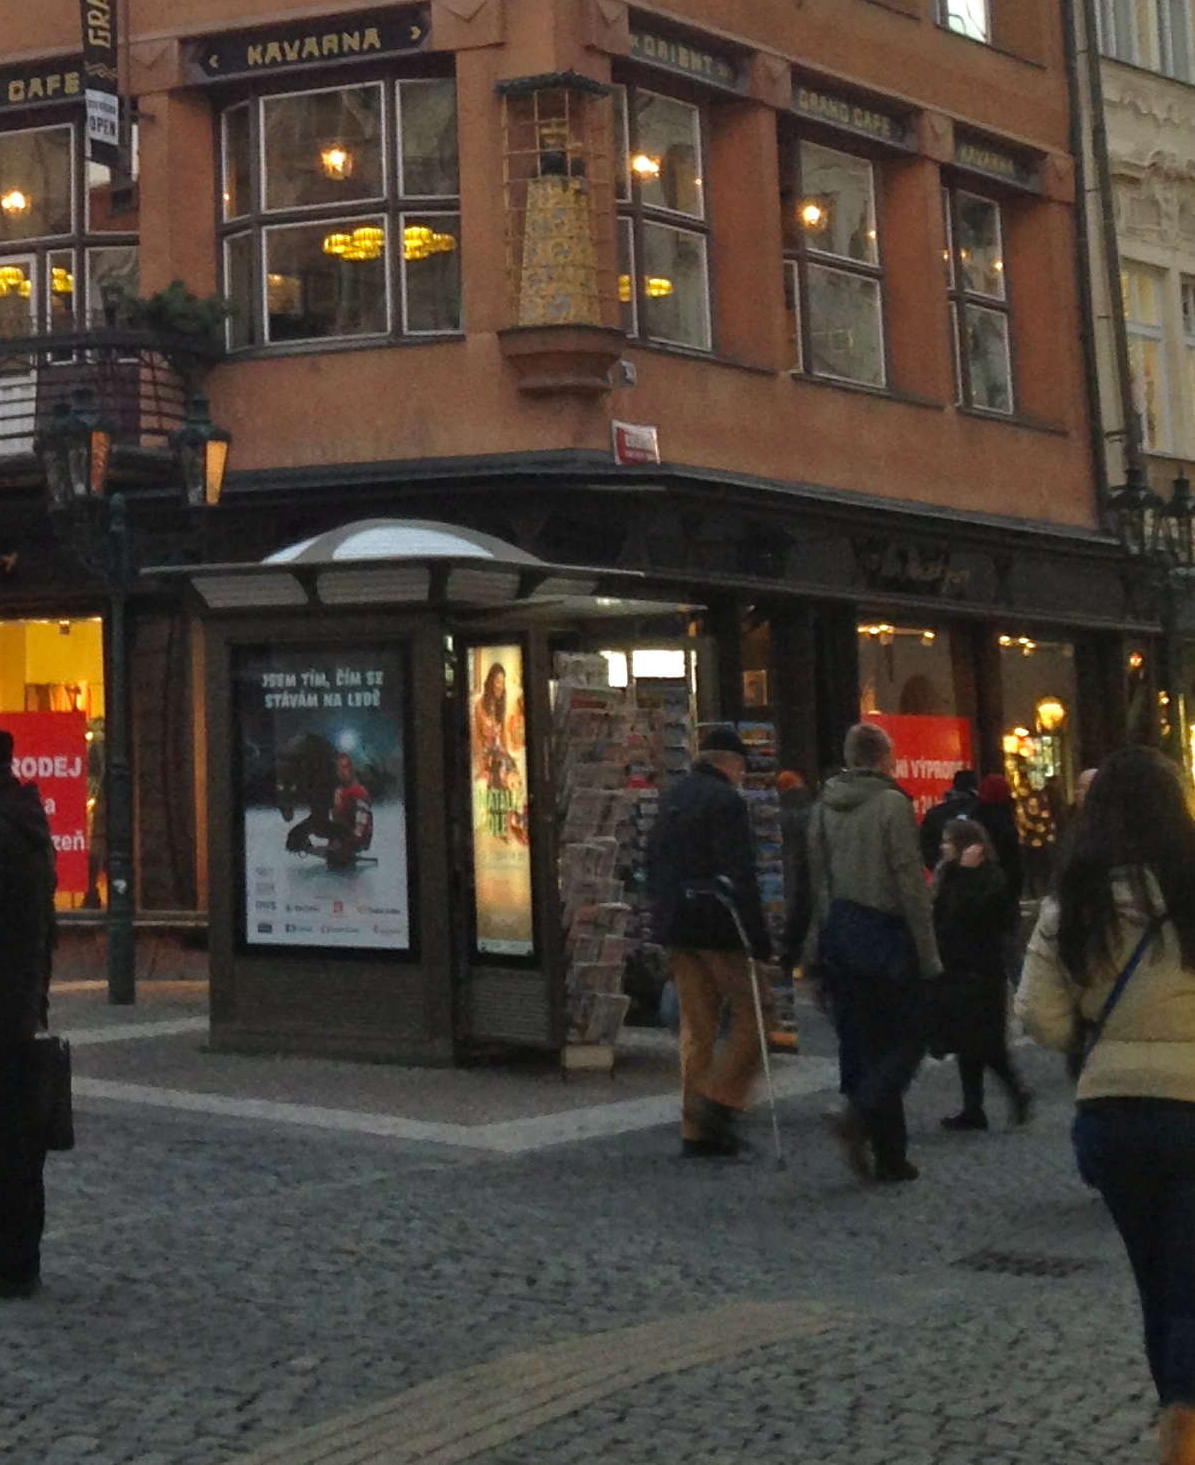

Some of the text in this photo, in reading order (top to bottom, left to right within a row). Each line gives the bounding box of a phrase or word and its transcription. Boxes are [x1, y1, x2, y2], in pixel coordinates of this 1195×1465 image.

[644, 35, 713, 74] ORIENT
[8, 71, 80, 102] CAFE
[88, 115, 116, 136] OPEN
[366, 671, 383, 685] SE
[323, 694, 342, 707] NA
[11, 756, 82, 777] RODEJ
